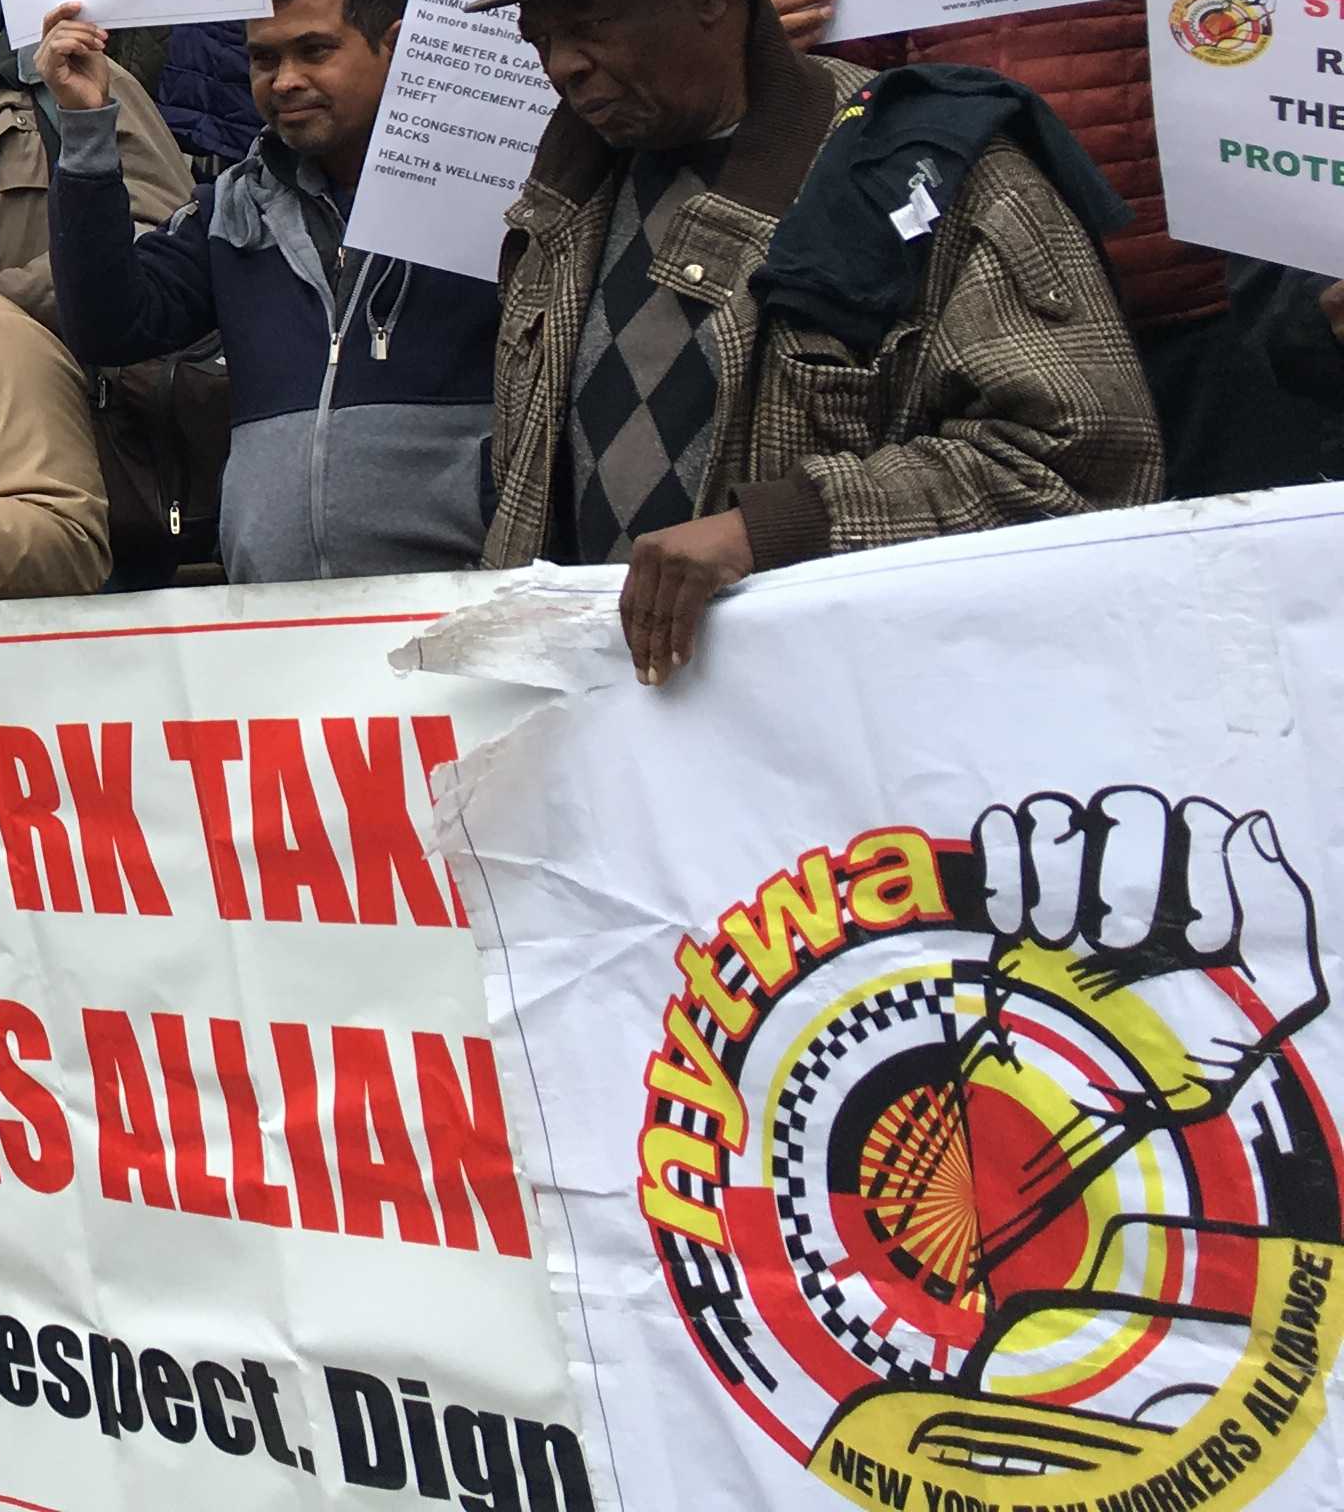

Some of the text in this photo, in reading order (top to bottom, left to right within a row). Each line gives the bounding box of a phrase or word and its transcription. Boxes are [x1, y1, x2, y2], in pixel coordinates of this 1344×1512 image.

[417, 9, 522, 44] No more slashing
[406, 48, 552, 90] CHARGED TO DRIVERS
[410, 33, 540, 71] RAISE METER & CAP
[396, 86, 437, 104] THEFT
[401, 72, 526, 110] TLC ENFORCEMENT
[385, 124, 430, 144] BACKS
[389, 110, 496, 145] NO CONGESTION
[374, 165, 437, 186] retirement
[378, 148, 515, 190] HEALTH & WELLNESS
[162, 715, 471, 928] TAX
[637, 825, 954, 1255] nytwa
[829, 1439, 912, 1511] NEW
[1241, 1245, 1333, 1437] ALLIANCE
